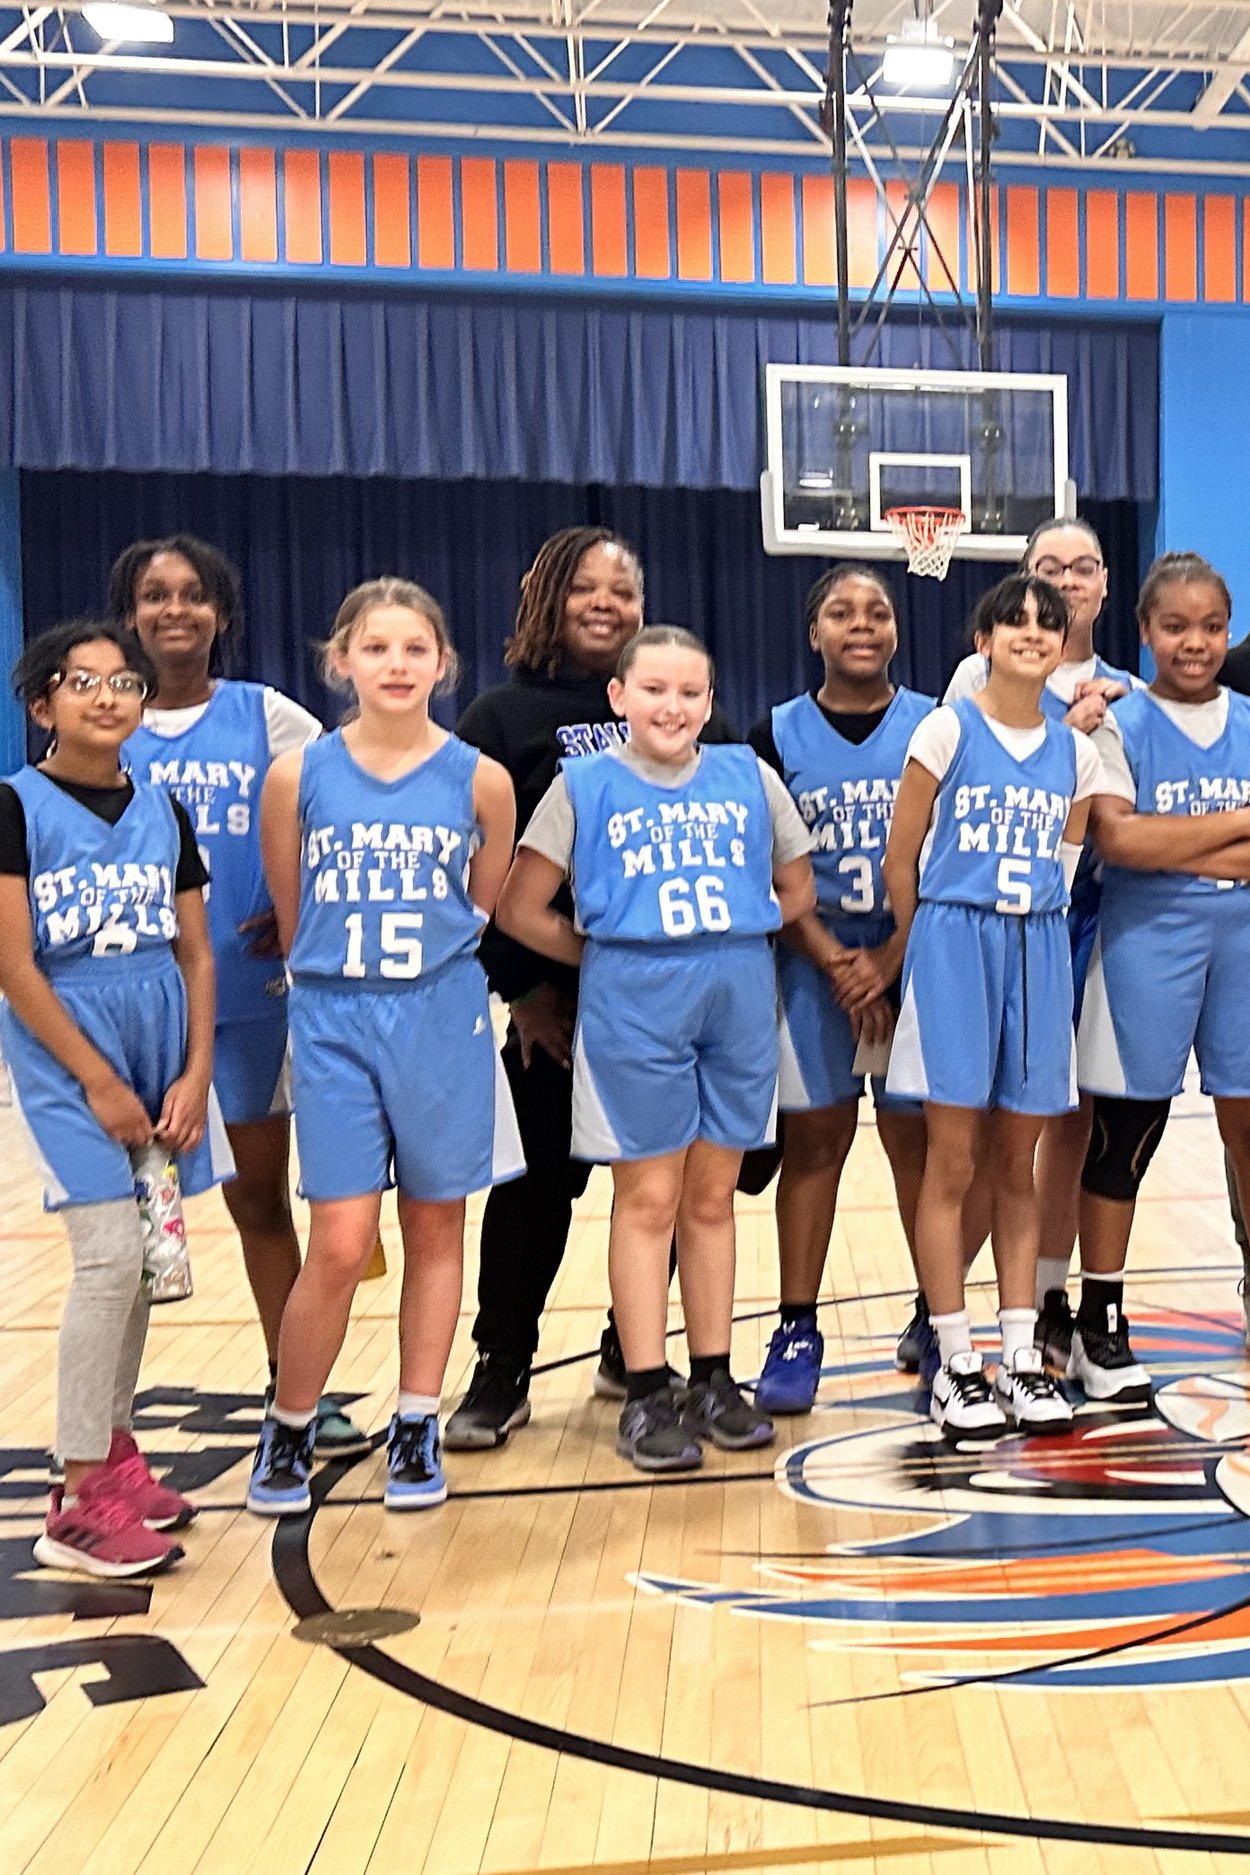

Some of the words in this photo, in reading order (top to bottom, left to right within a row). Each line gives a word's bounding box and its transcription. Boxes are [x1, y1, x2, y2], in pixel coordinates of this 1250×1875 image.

[149, 757, 256, 799] MARY
[171, 785, 216, 806] THE
[1156, 780, 1195, 814] ST.
[800, 786, 837, 824] ST.
[842, 779, 901, 804] MA
[832, 805, 856, 823] OF
[954, 785, 998, 819] ST.
[991, 807, 1015, 825] OF
[1021, 810, 1056, 831] THE
[608, 808, 655, 849] ST.
[658, 800, 749, 835] MARY
[650, 825, 675, 843] OF
[682, 822, 719, 840] THE
[810, 820, 892, 851] MIL
[307, 825, 344, 870] ST.
[351, 822, 462, 866] MARY
[336, 850, 365, 870] OF
[373, 850, 421, 870] THE
[622, 838, 746, 879] MILLS
[33, 865, 88, 912] ST.
[80, 886, 107, 906] OF
[314, 866, 450, 905] MILLS
[995, 858, 1032, 915] 5
[46, 902, 178, 945] MILLS
[658, 874, 731, 938] 66
[342, 911, 424, 979] 15
